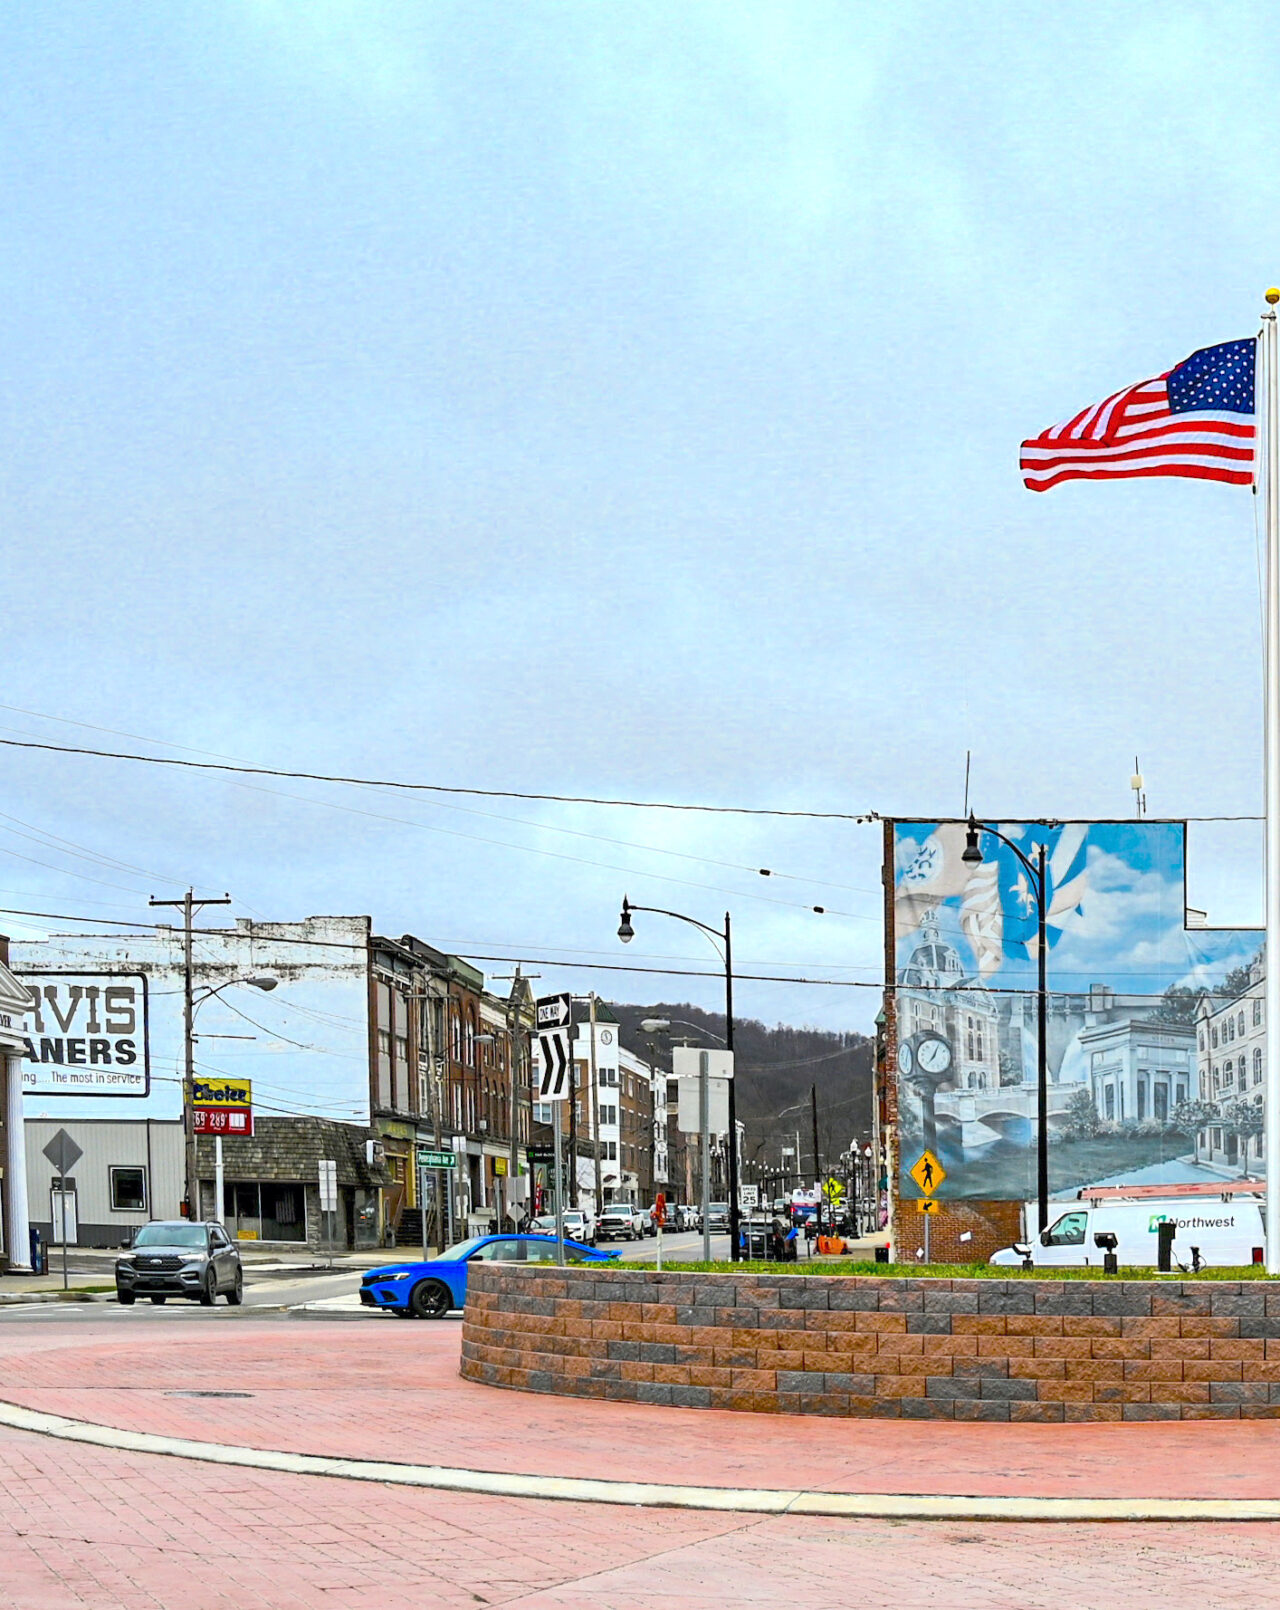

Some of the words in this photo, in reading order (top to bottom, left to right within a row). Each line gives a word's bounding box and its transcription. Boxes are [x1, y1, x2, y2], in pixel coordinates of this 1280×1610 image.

[539, 1006, 549, 1021] ONE
[550, 1004, 561, 1018] WAY
[70, 1072, 93, 1083] most
[96, 1073, 105, 1083] in
[107, 1073, 141, 1084] service
[743, 1196, 756, 1205] 25
[1168, 1216, 1235, 1229] Northwest
